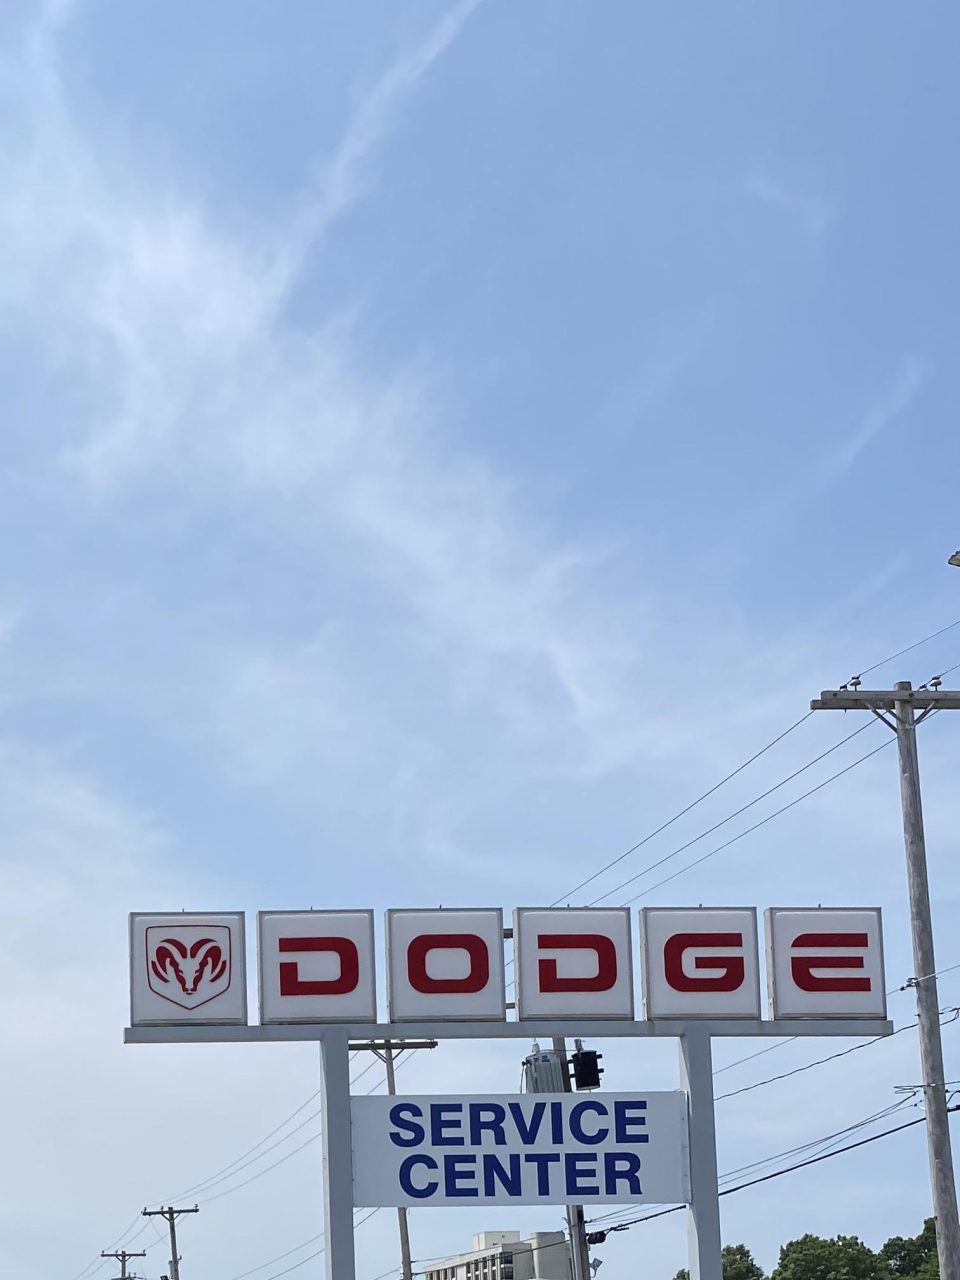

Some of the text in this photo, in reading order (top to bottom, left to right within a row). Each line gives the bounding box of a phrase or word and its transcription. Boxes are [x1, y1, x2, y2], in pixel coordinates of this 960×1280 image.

[277, 931, 872, 996] DODGE
[388, 1099, 651, 1148] SERVICE
[397, 1150, 643, 1199] CENTER
